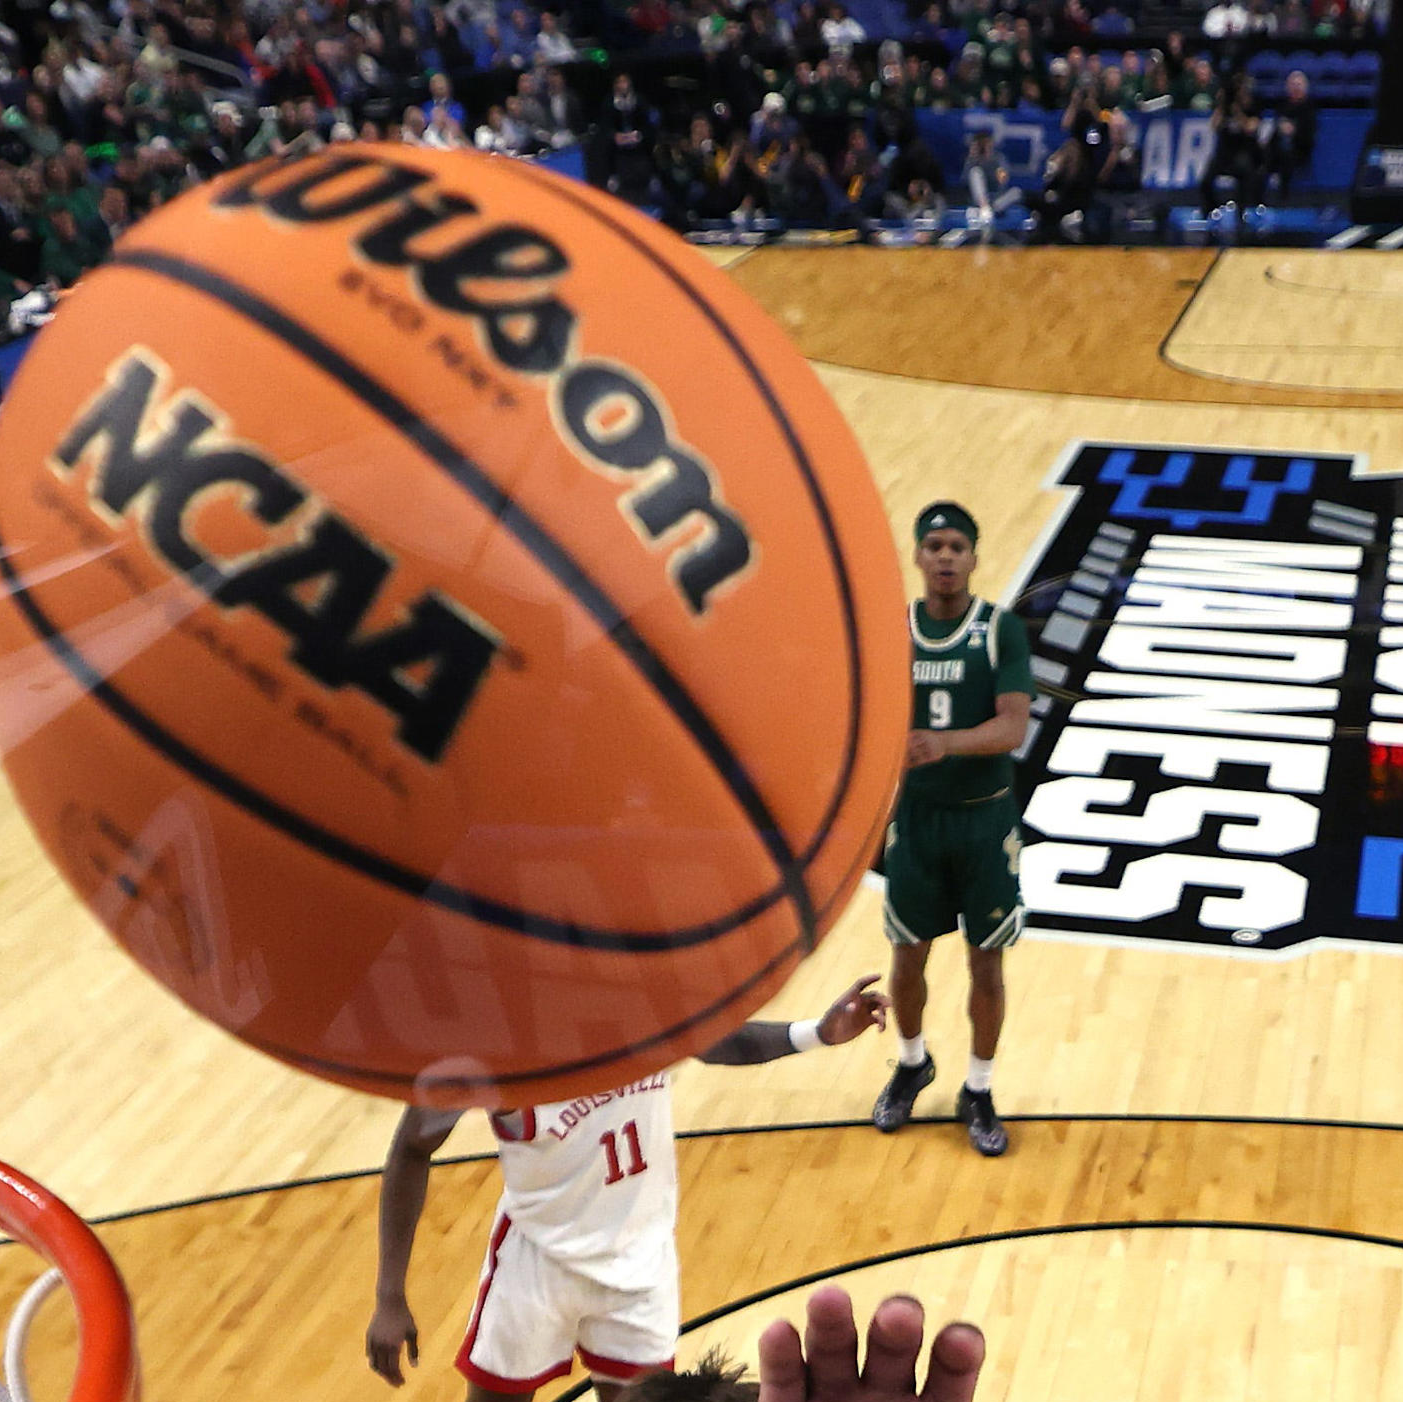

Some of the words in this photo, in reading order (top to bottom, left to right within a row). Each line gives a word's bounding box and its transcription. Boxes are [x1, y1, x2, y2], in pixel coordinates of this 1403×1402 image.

[206, 152, 753, 620] Wilson
[46, 345, 508, 768] NCAA
[928, 690, 953, 729] 9
[1018, 533, 1364, 929] MADNESS
[546, 1070, 665, 1143] LOUISVILL
[599, 1119, 648, 1185] 11
